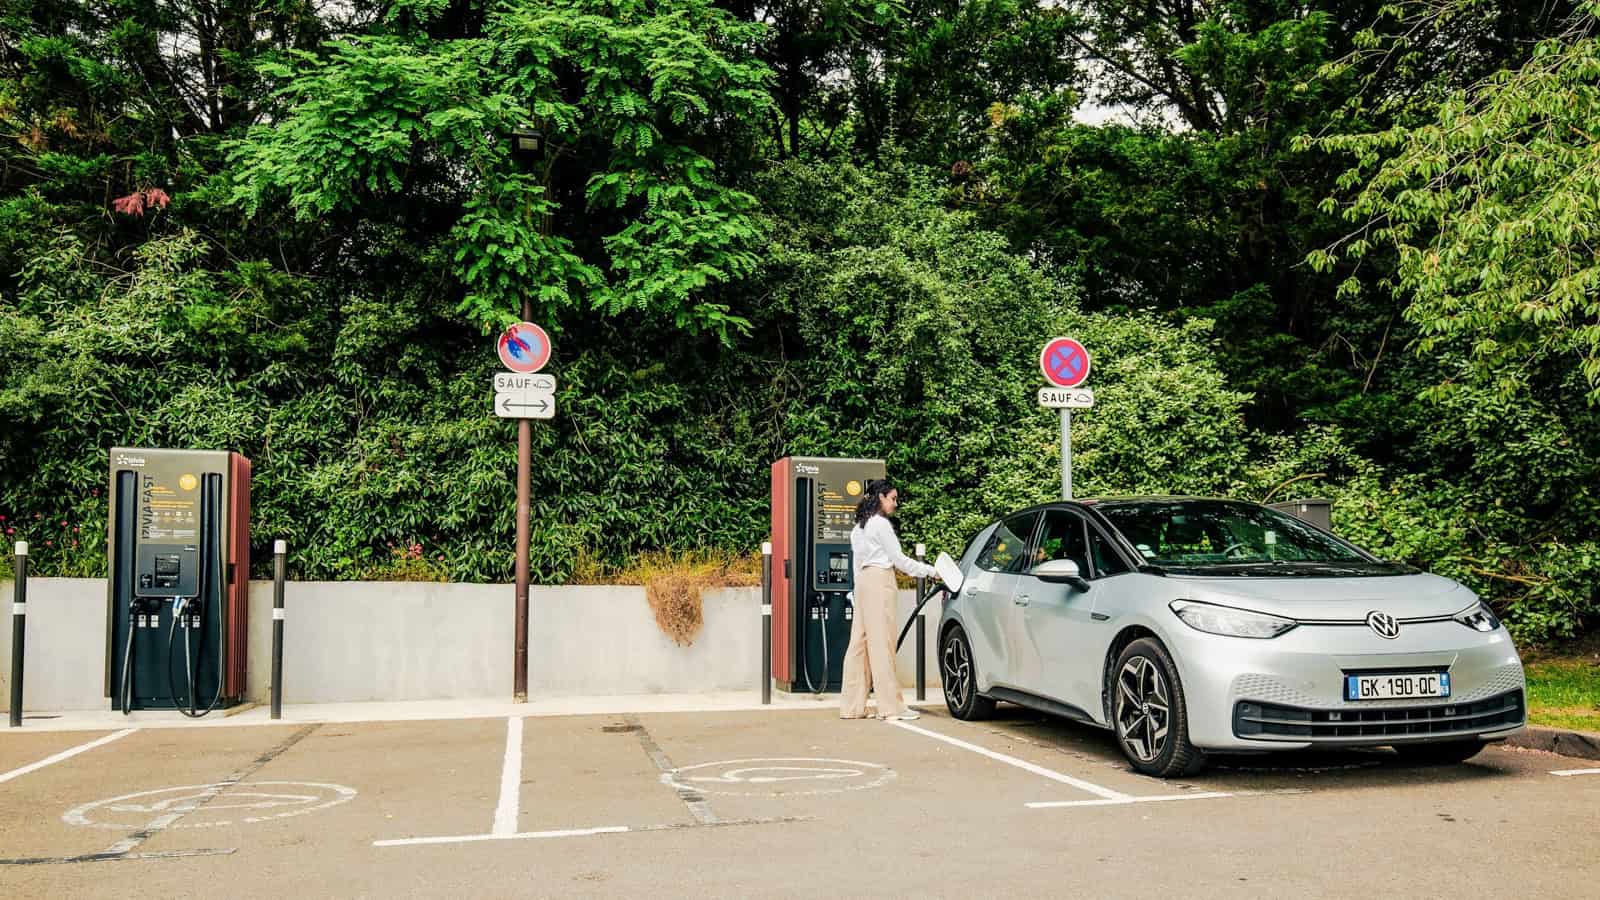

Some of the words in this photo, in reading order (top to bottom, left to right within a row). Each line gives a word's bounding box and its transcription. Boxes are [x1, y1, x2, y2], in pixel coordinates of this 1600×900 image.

[498, 377, 531, 389] SAUF
[1042, 392, 1072, 403] SAUF
[143, 475, 153, 503] FAST
[142, 506, 153, 539] IZIVIA
